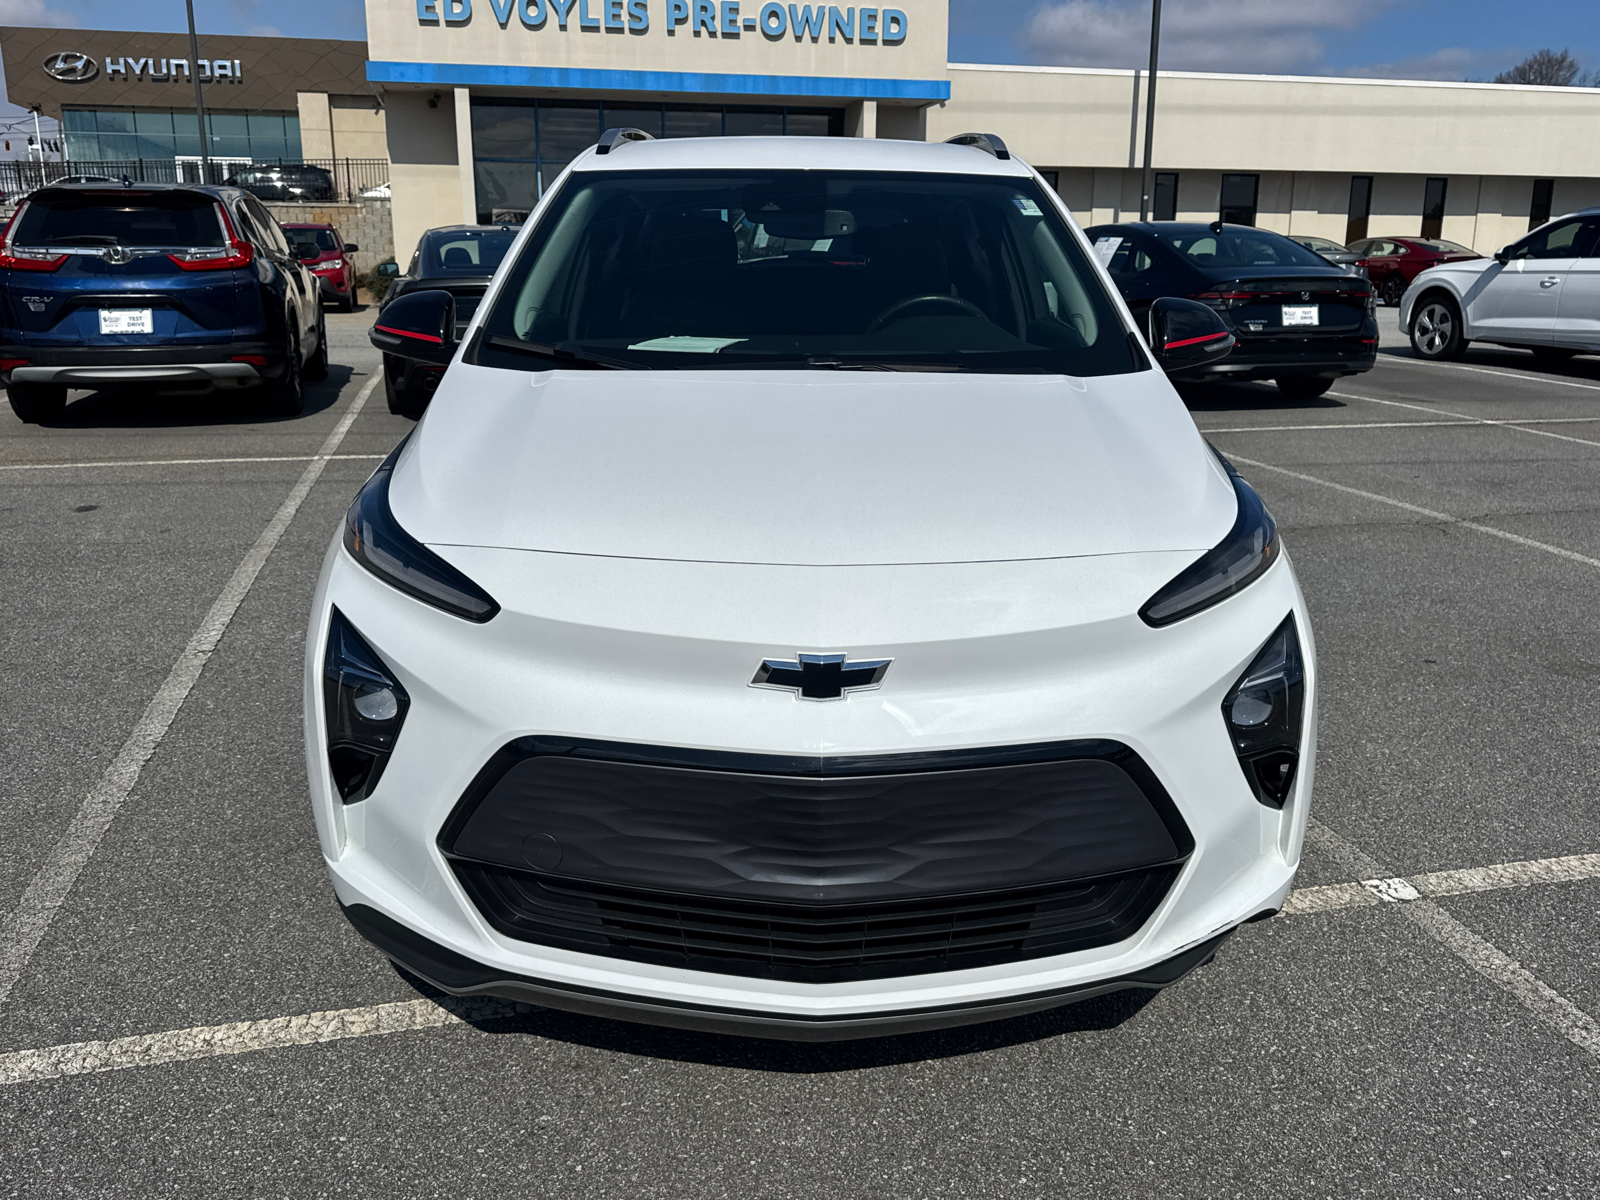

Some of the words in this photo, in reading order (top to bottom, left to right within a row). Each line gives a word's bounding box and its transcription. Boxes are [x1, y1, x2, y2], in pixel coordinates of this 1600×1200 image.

[417, 0, 472, 25] ED
[490, 0, 649, 34] VOYLES
[666, 0, 908, 44] PRE-OWNED
[105, 56, 242, 80] HYUNDAI
